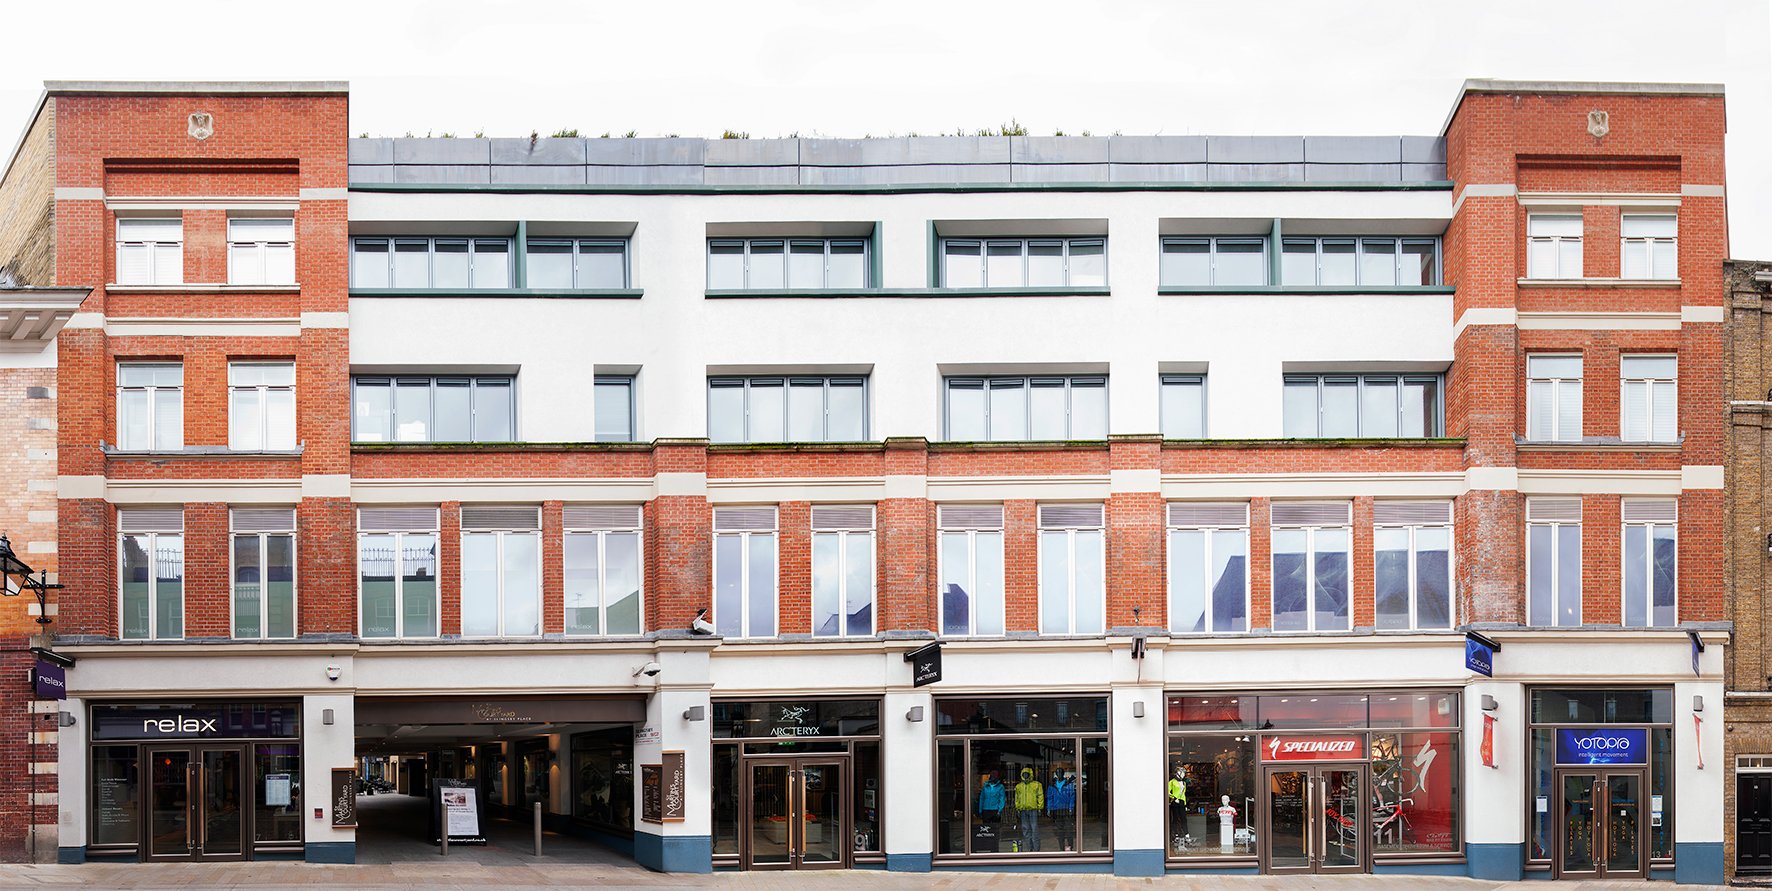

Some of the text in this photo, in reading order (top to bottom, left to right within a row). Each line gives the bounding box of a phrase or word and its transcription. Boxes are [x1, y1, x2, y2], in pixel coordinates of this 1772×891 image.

[368, 625, 390, 633] relax
[38, 675, 64, 688] relax
[144, 714, 217, 733] relax
[1281, 741, 1356, 753] SPECIALIZED
[1325, 808, 1340, 818] JOY
[1373, 828, 1393, 844] 11
[854, 834, 866, 851] 9
[1652, 850, 1661, 858] 13
